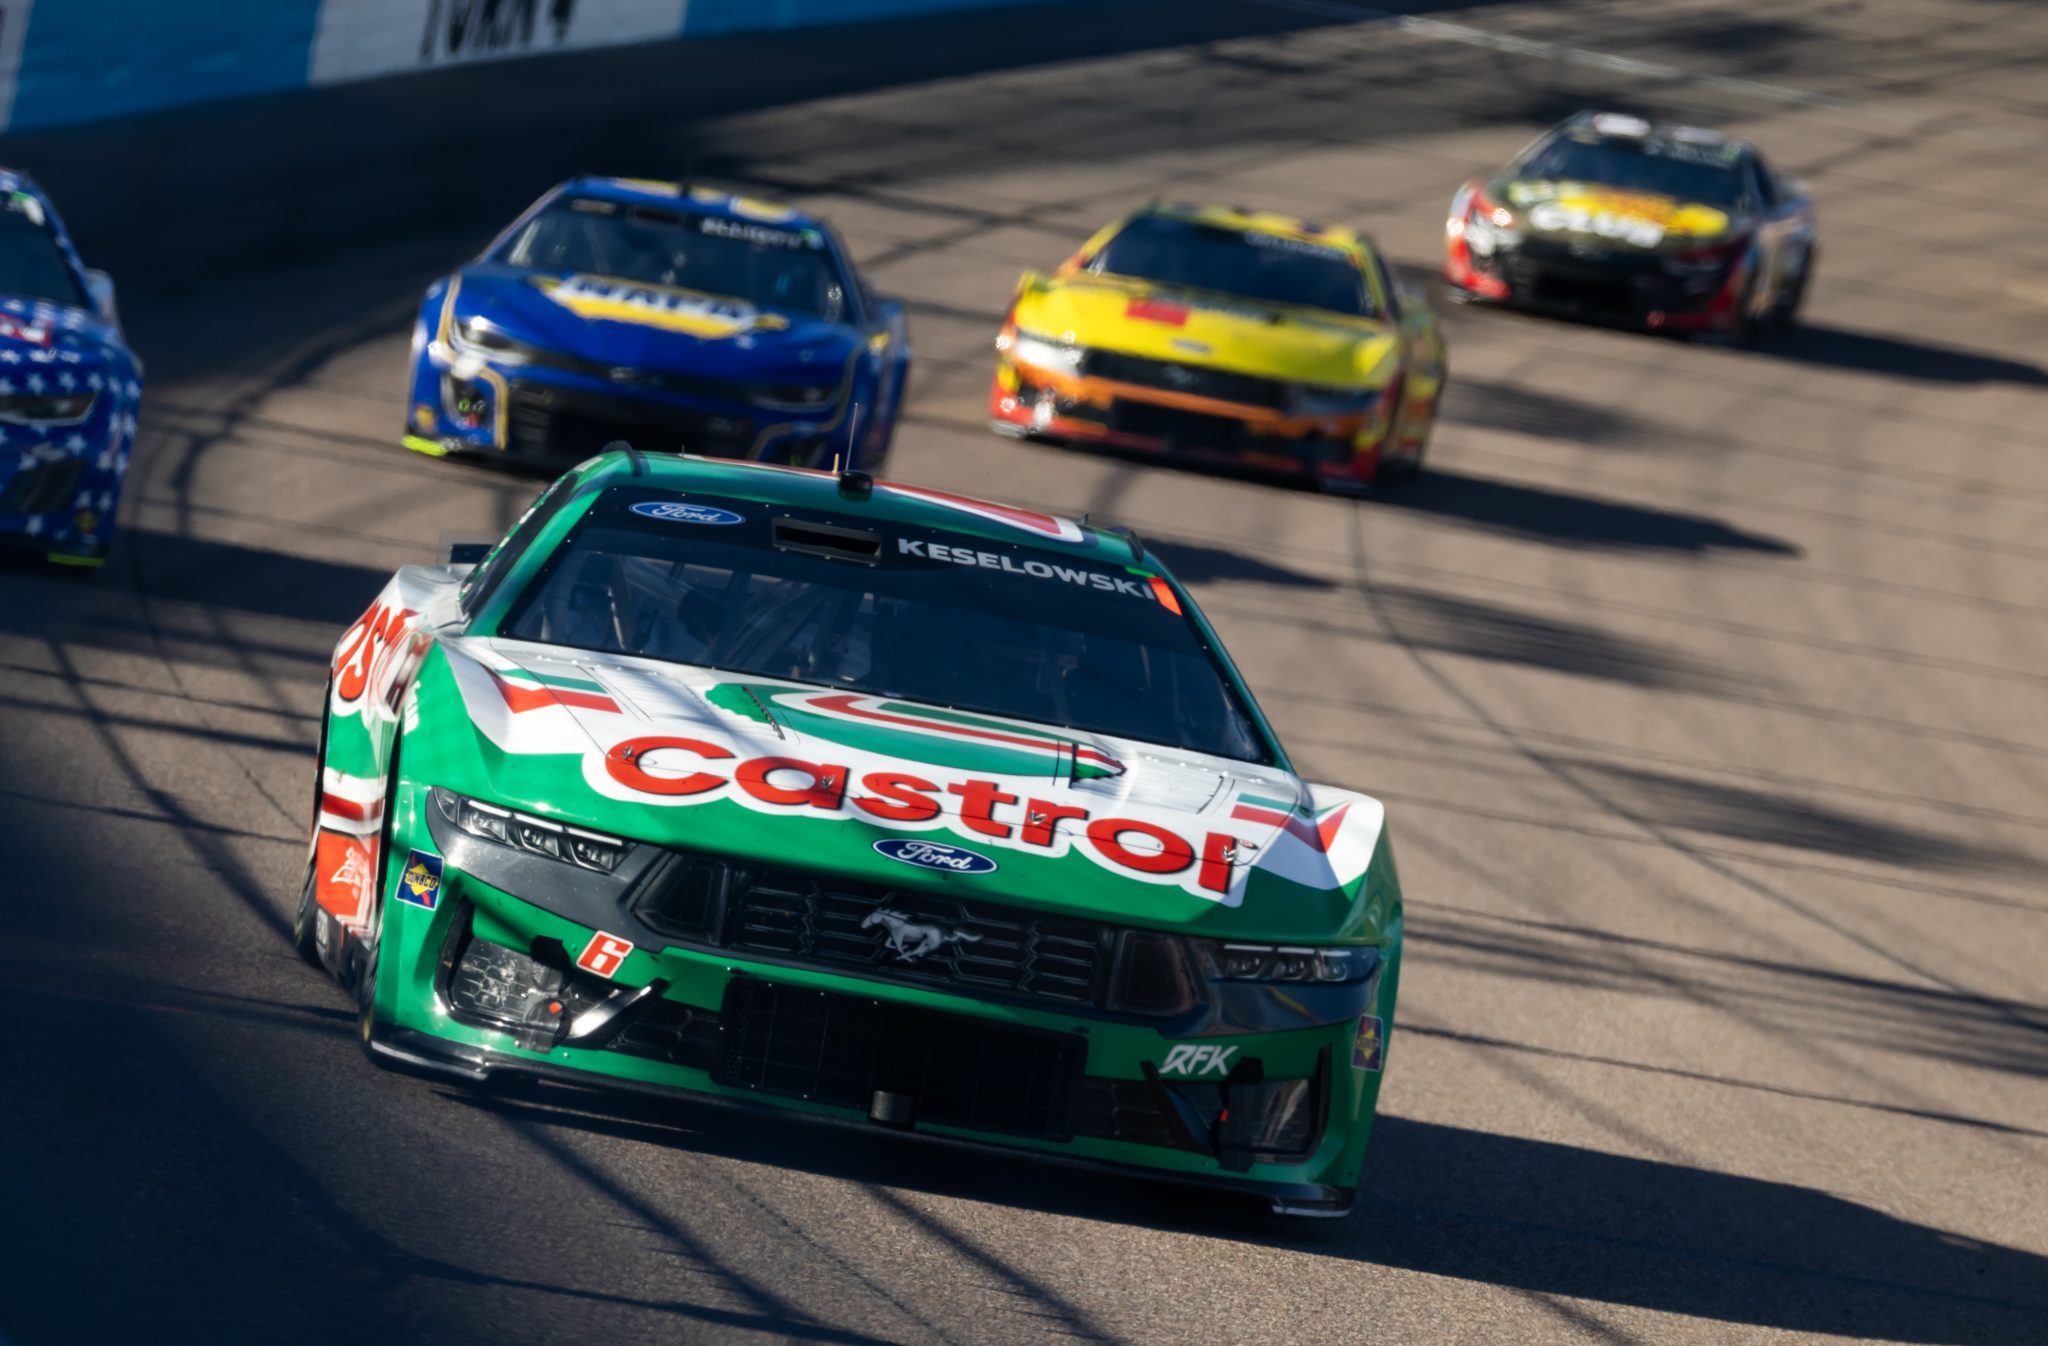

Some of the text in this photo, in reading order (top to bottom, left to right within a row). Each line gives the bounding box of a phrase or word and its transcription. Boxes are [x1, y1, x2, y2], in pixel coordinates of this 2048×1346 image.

[898, 538, 1156, 600] KESELOWSKI
[605, 736, 1236, 895] Castrol
[896, 842, 973, 869] Ford
[577, 930, 634, 979] 6
[1158, 1044, 1239, 1075] RFK
